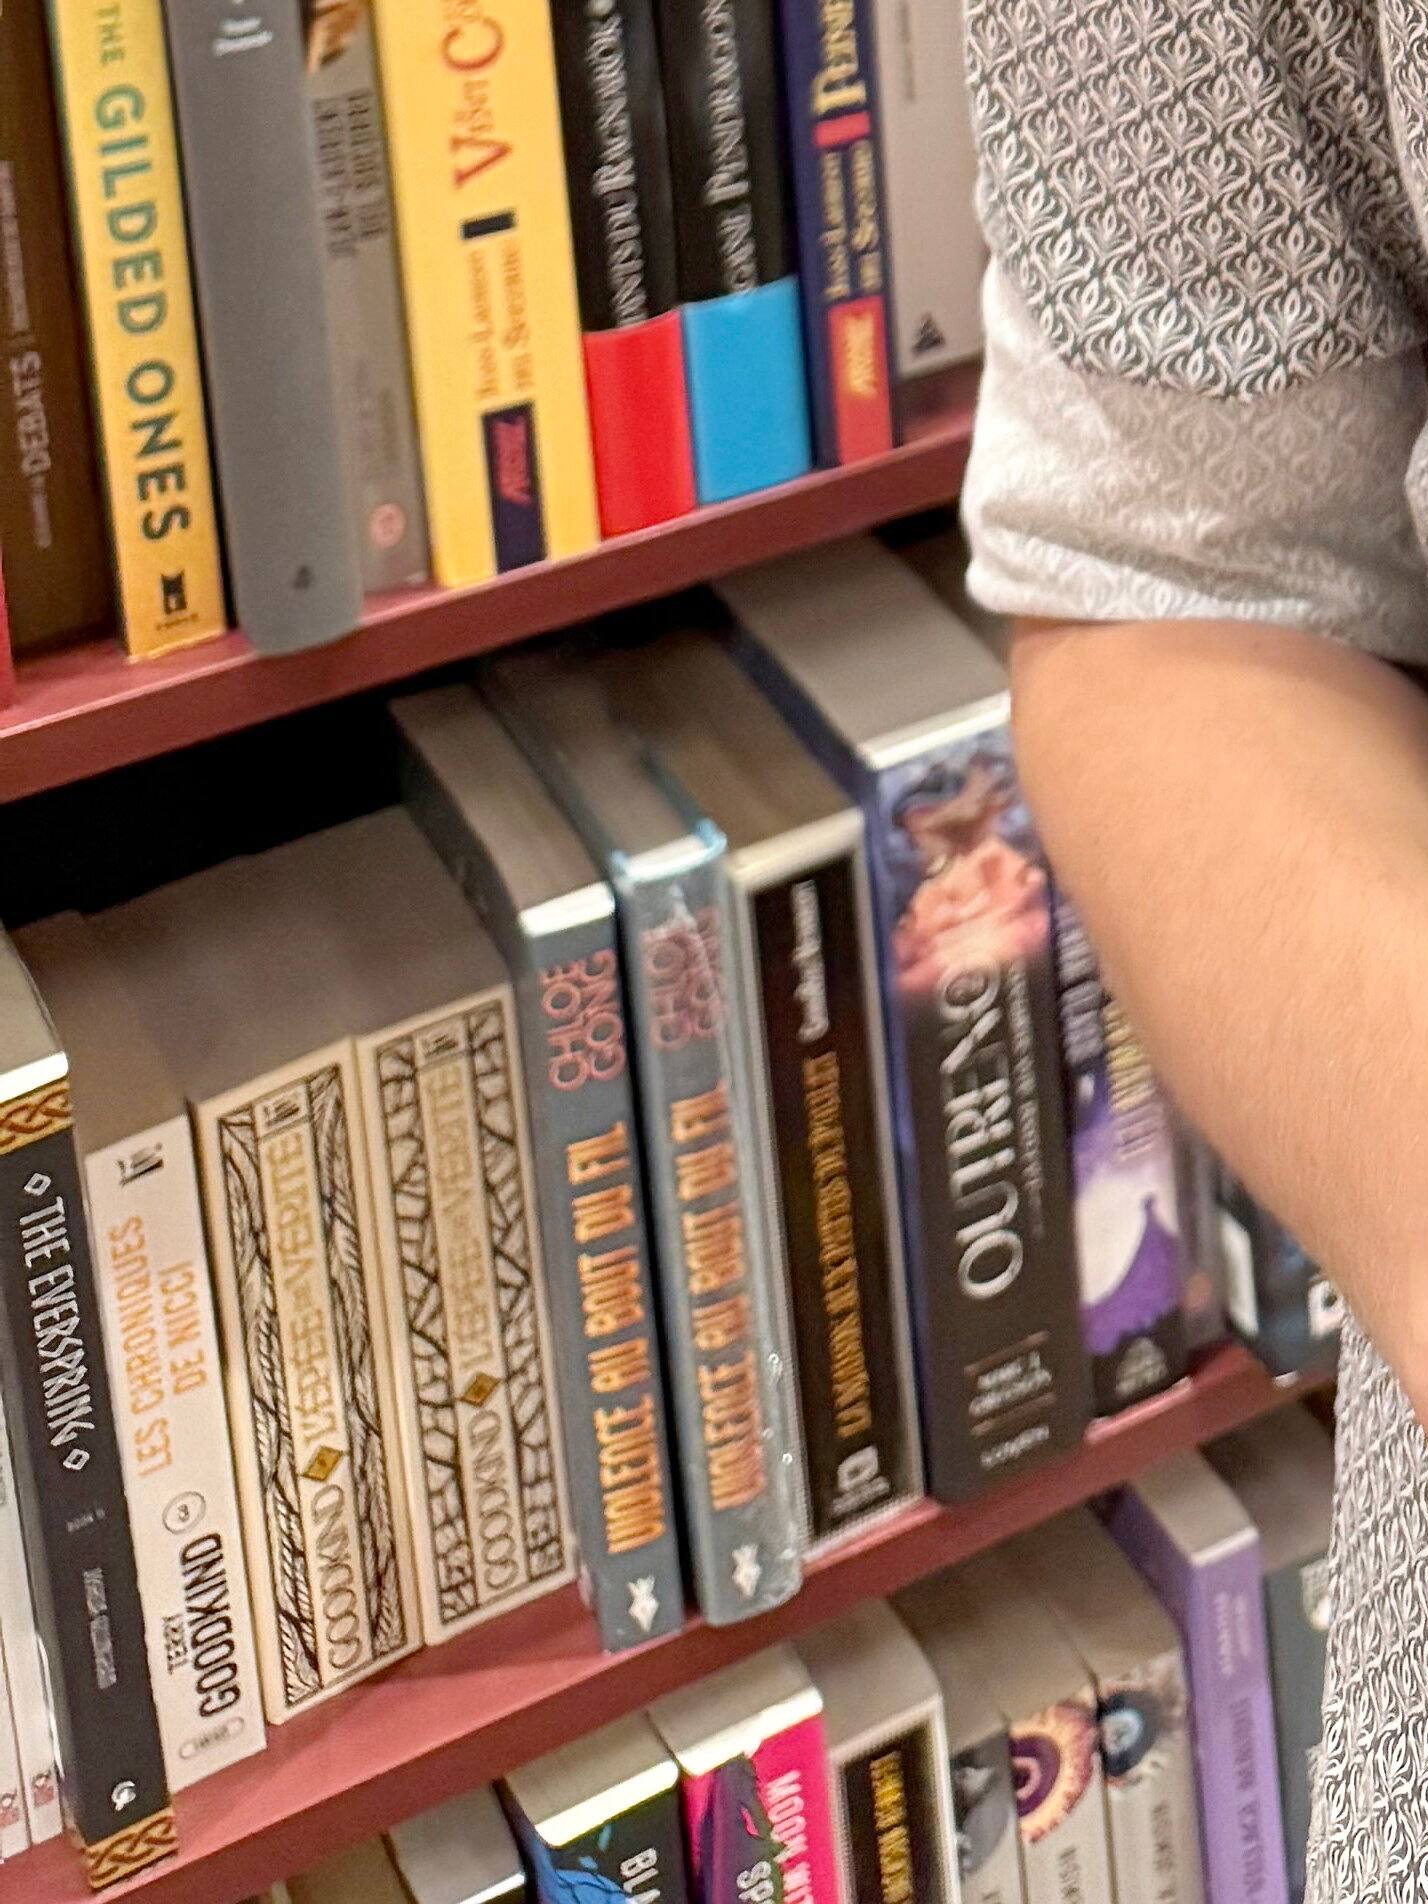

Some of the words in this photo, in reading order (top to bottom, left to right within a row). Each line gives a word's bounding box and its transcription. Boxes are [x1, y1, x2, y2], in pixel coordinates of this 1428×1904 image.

[92, 5, 128, 65] THE
[92, 83, 171, 336] GILDED
[124, 358, 192, 544] ONES
[538, 964, 590, 1093] CHLOE
[577, 947, 627, 1082] GONG
[566, 1119, 632, 1187] FIL
[20, 1195, 70, 1269] THE
[571, 1184, 635, 1247] DU
[107, 1214, 166, 1418] CHRONIQUES
[158, 1258, 203, 1349] NICCI
[577, 1244, 644, 1339] BOUT
[170, 1350, 208, 1396] DE
[131, 1418, 173, 1480] LES
[467, 1408, 520, 1592] GOODKIND
[178, 1532, 242, 1719] GOODKIND
[309, 1484, 366, 1673] GOODKIND
[160, 1614, 192, 1678] TERRY
